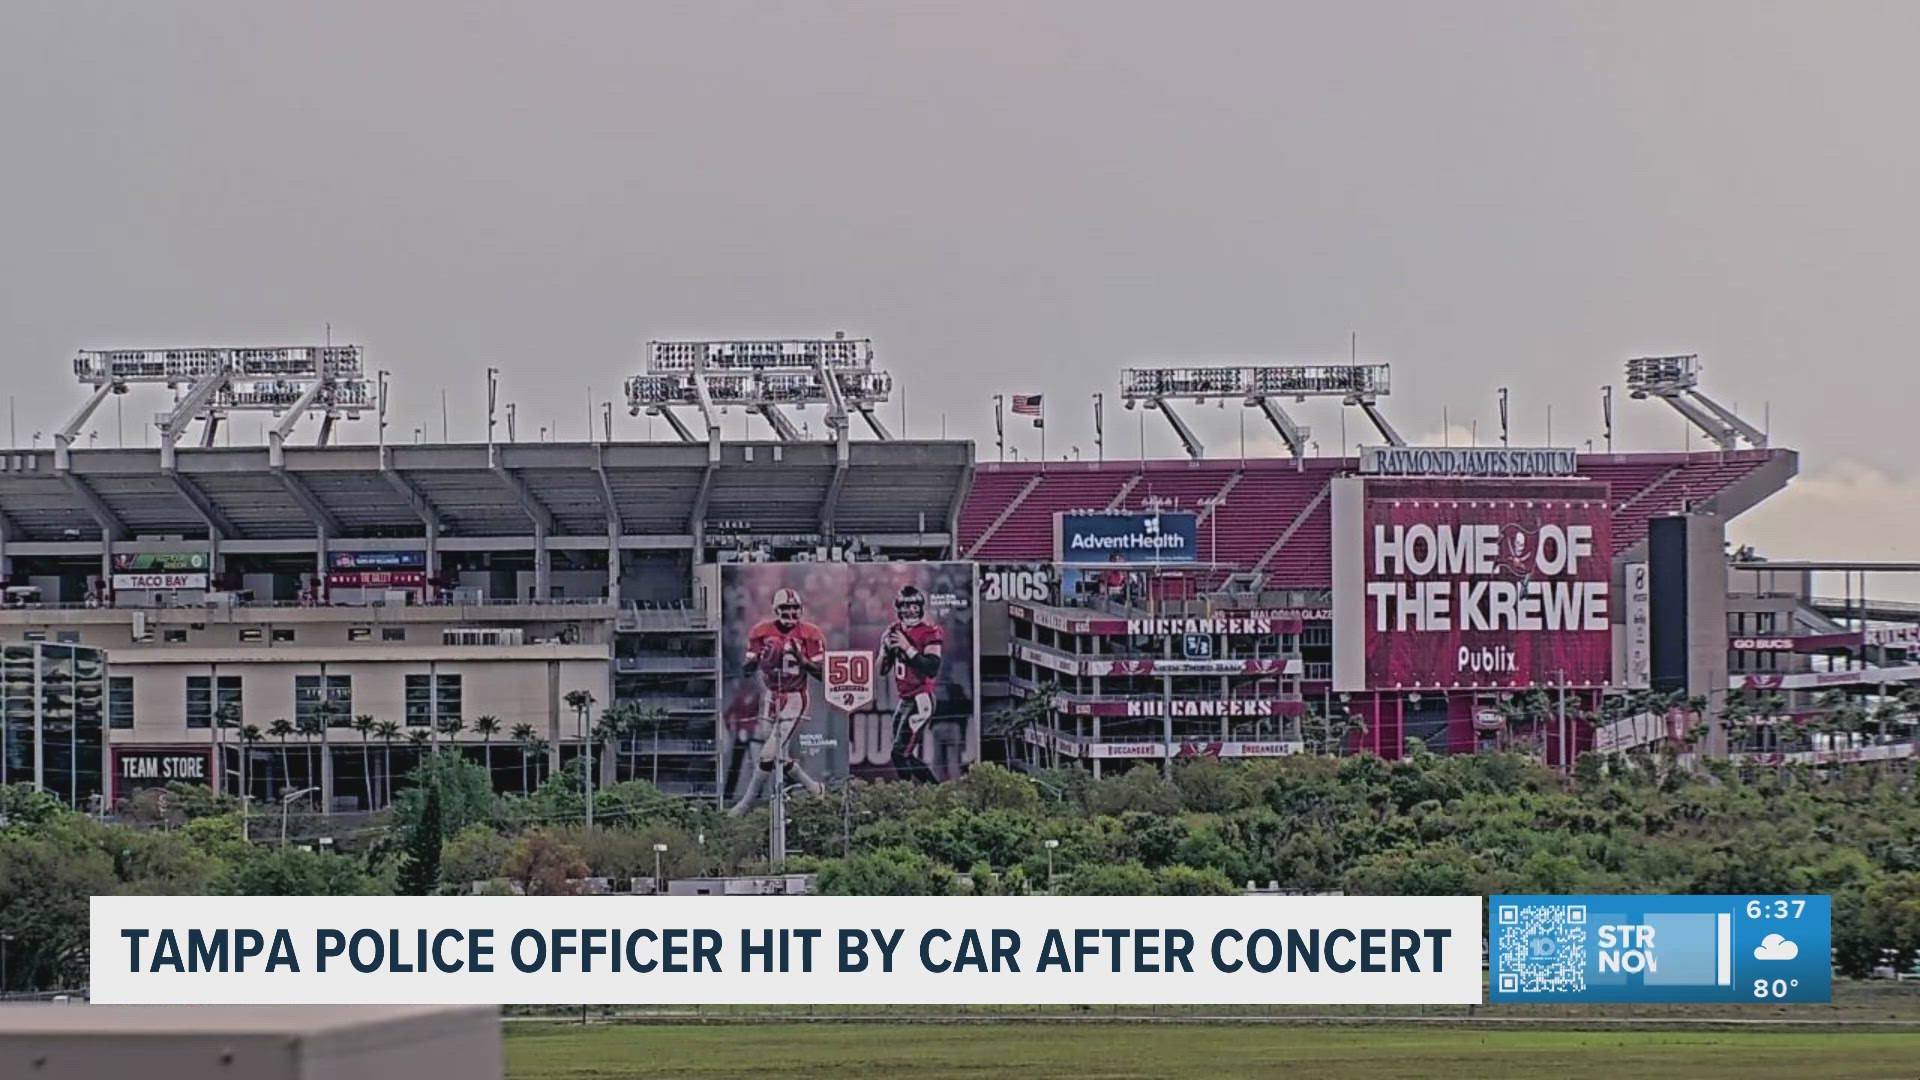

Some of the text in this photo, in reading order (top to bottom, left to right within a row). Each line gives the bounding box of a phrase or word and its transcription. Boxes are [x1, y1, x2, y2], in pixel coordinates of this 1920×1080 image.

[1376, 450, 1576, 474] RAYMOND JAMES STADIUM
[1071, 533, 1184, 549] AdventHealth
[1374, 524, 1592, 575] HOME OF
[131, 576, 188, 587] TACO BAY
[984, 572, 1049, 600] BUCS
[1367, 581, 1450, 631] THE
[1460, 581, 1609, 631] KREWE
[829, 655, 870, 685] 50
[1458, 644, 1516, 672] Publix
[121, 756, 205, 778] TEAM STORE
